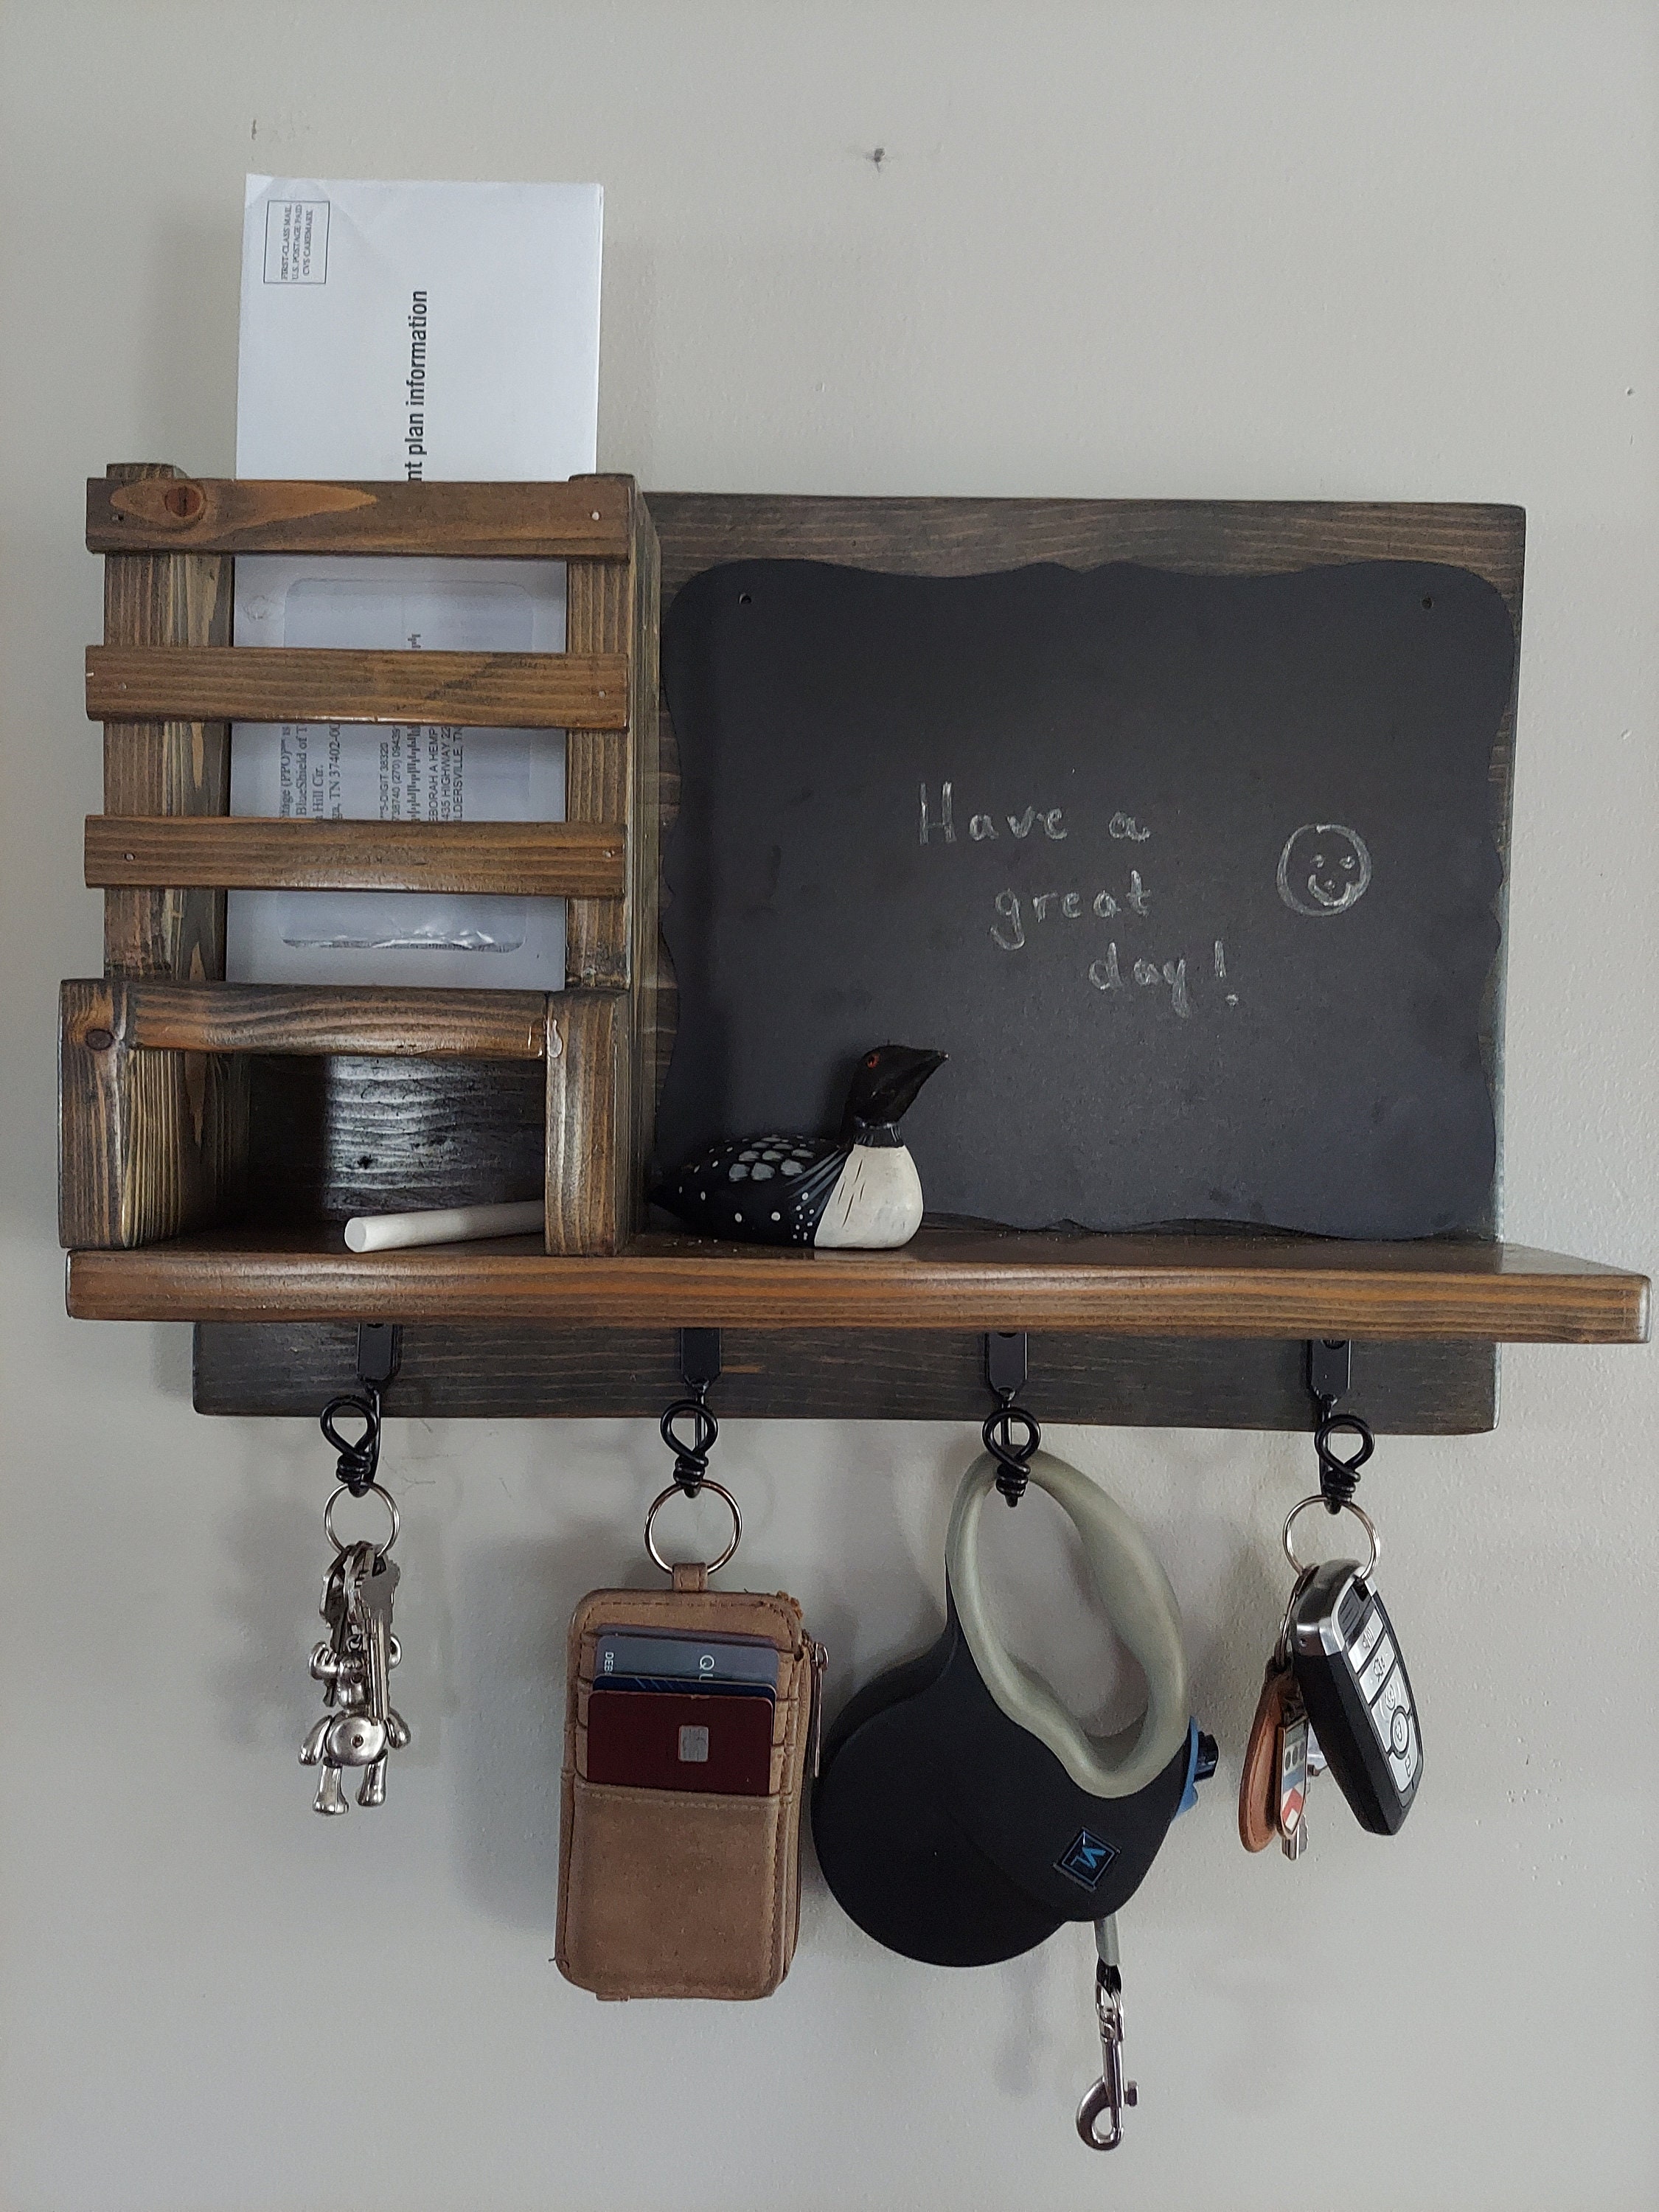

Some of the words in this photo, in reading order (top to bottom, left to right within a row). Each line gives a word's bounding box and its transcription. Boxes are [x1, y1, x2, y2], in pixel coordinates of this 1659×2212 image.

[284, 204, 292, 226] MAIL
[303, 209, 313, 257] CAREMARK
[281, 228, 291, 280] FIRST-CLASS
[293, 226, 301, 263] POSTAGE
[302, 257, 310, 275] CVS
[406, 291, 428, 406] information
[405, 413, 428, 455] plan
[295, 736, 307, 750] of
[295, 753, 307, 815] BlueShield
[329, 780, 341, 800] TN
[392, 759, 402, 784] (270)
[428, 765, 438, 773] A
[441, 742, 451, 797] HIGHWAY
[312, 790, 324, 813] Hill
[919, 779, 1068, 845] Have
[1108, 811, 1150, 843] a
[990, 869, 1152, 951] great
[1088, 939, 1239, 1020] day!
